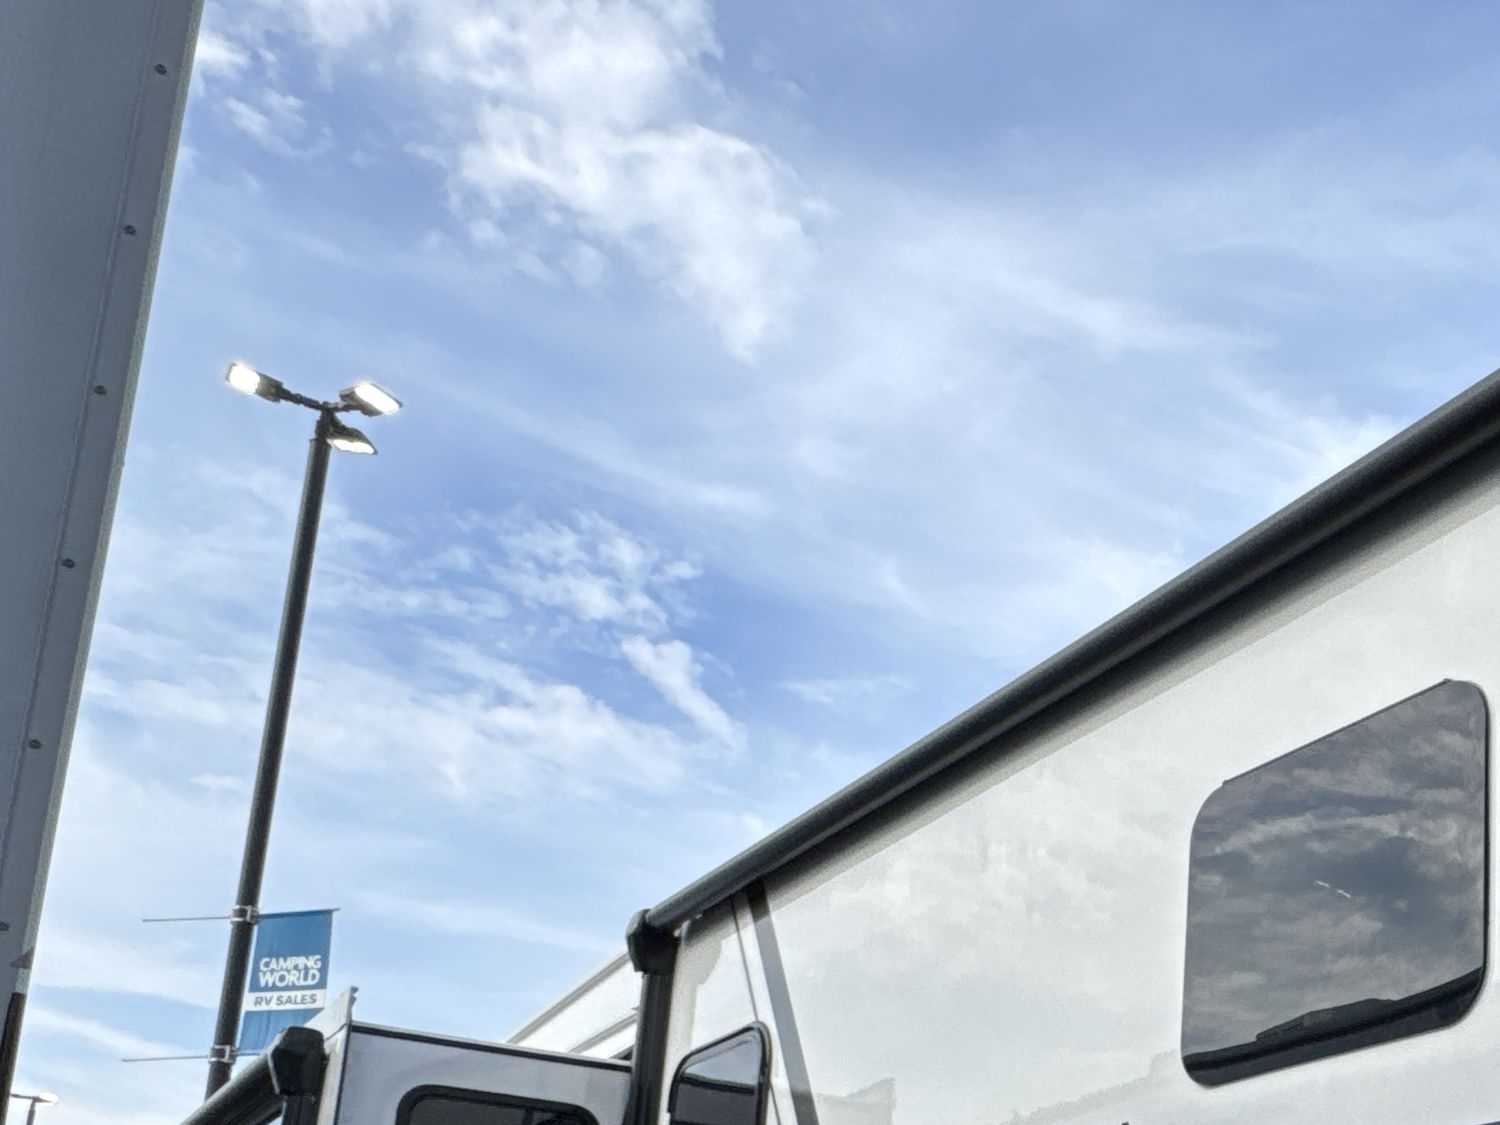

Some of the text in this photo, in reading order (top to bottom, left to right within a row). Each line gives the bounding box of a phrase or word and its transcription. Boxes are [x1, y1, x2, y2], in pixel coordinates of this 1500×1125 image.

[260, 955, 322, 972] CAMPING
[259, 970, 321, 988] WORLD
[255, 993, 317, 1007] RV SALES
